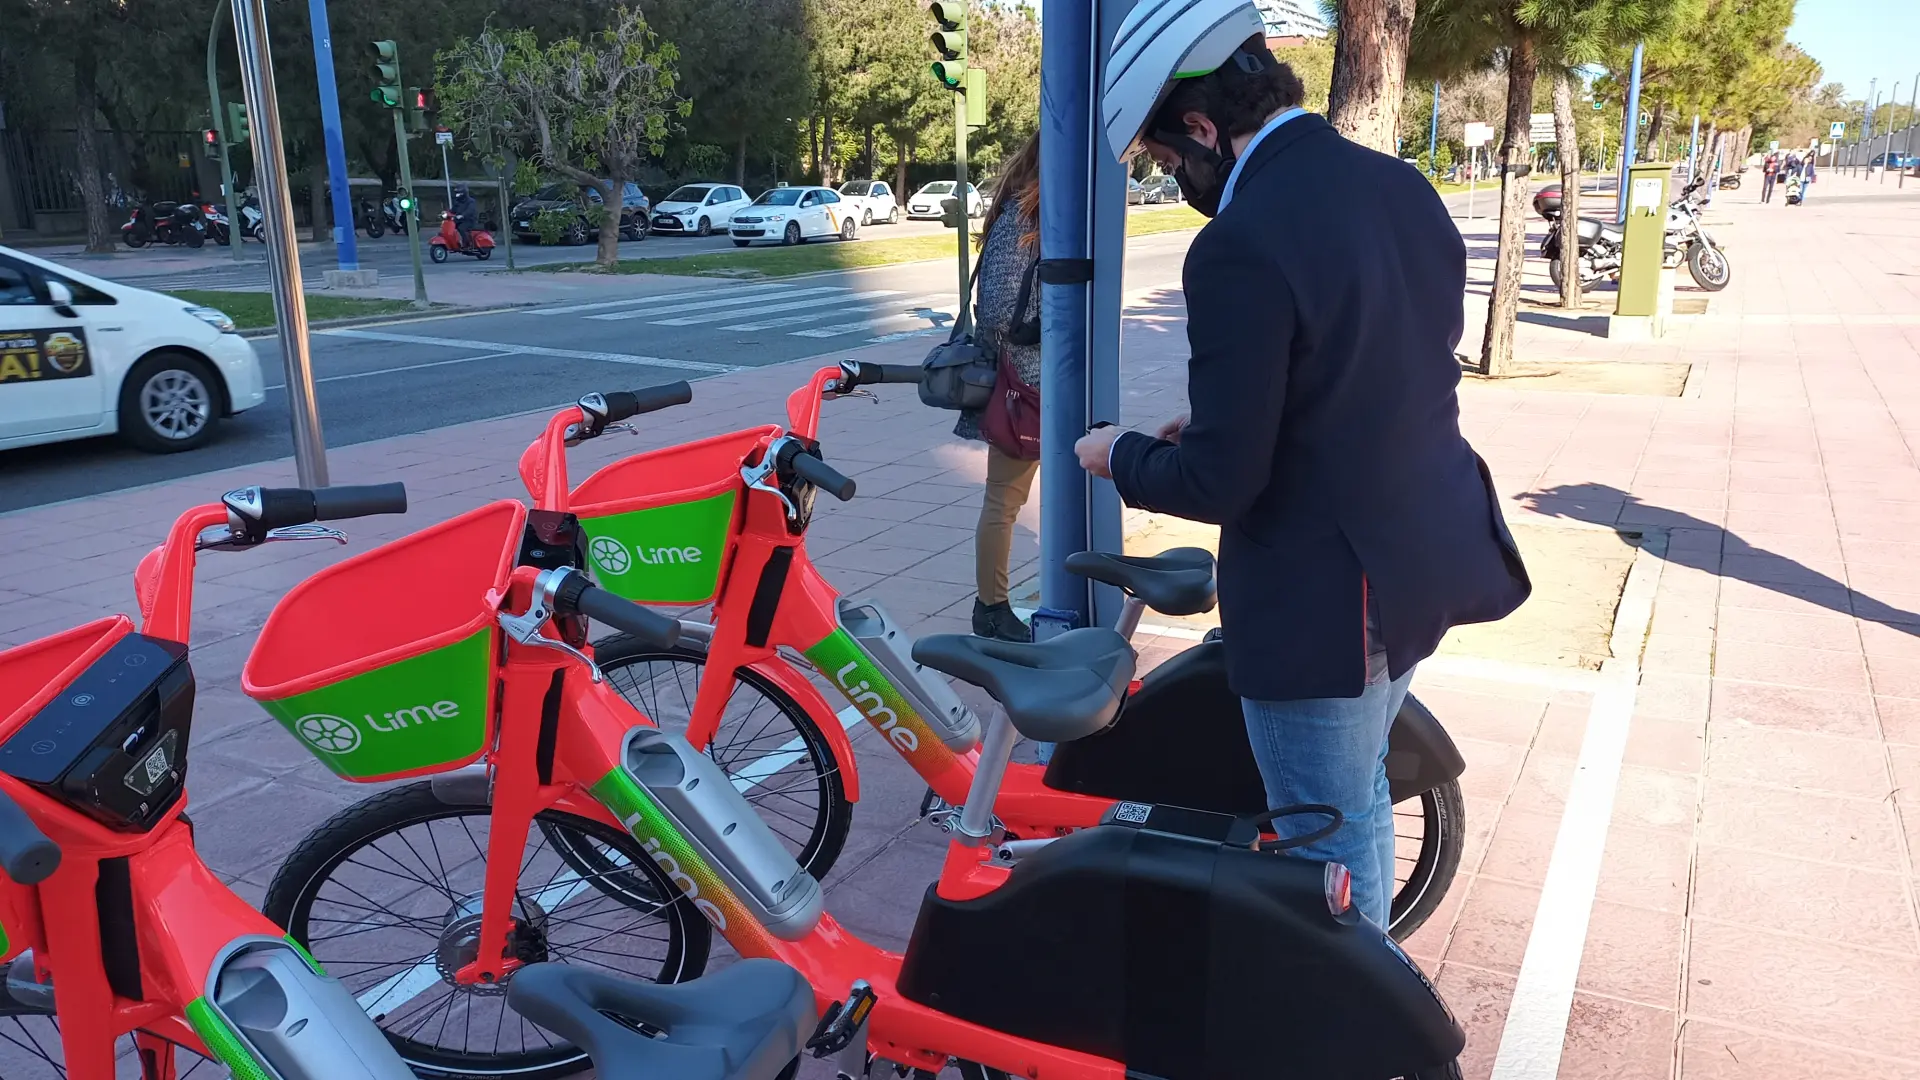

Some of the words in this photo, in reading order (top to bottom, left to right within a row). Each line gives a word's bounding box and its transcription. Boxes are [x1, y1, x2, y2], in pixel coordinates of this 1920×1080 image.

[636, 546, 702, 565] Lime
[364, 700, 460, 732] Lime
[837, 661, 918, 752] Lime
[626, 812, 727, 932] Lime
